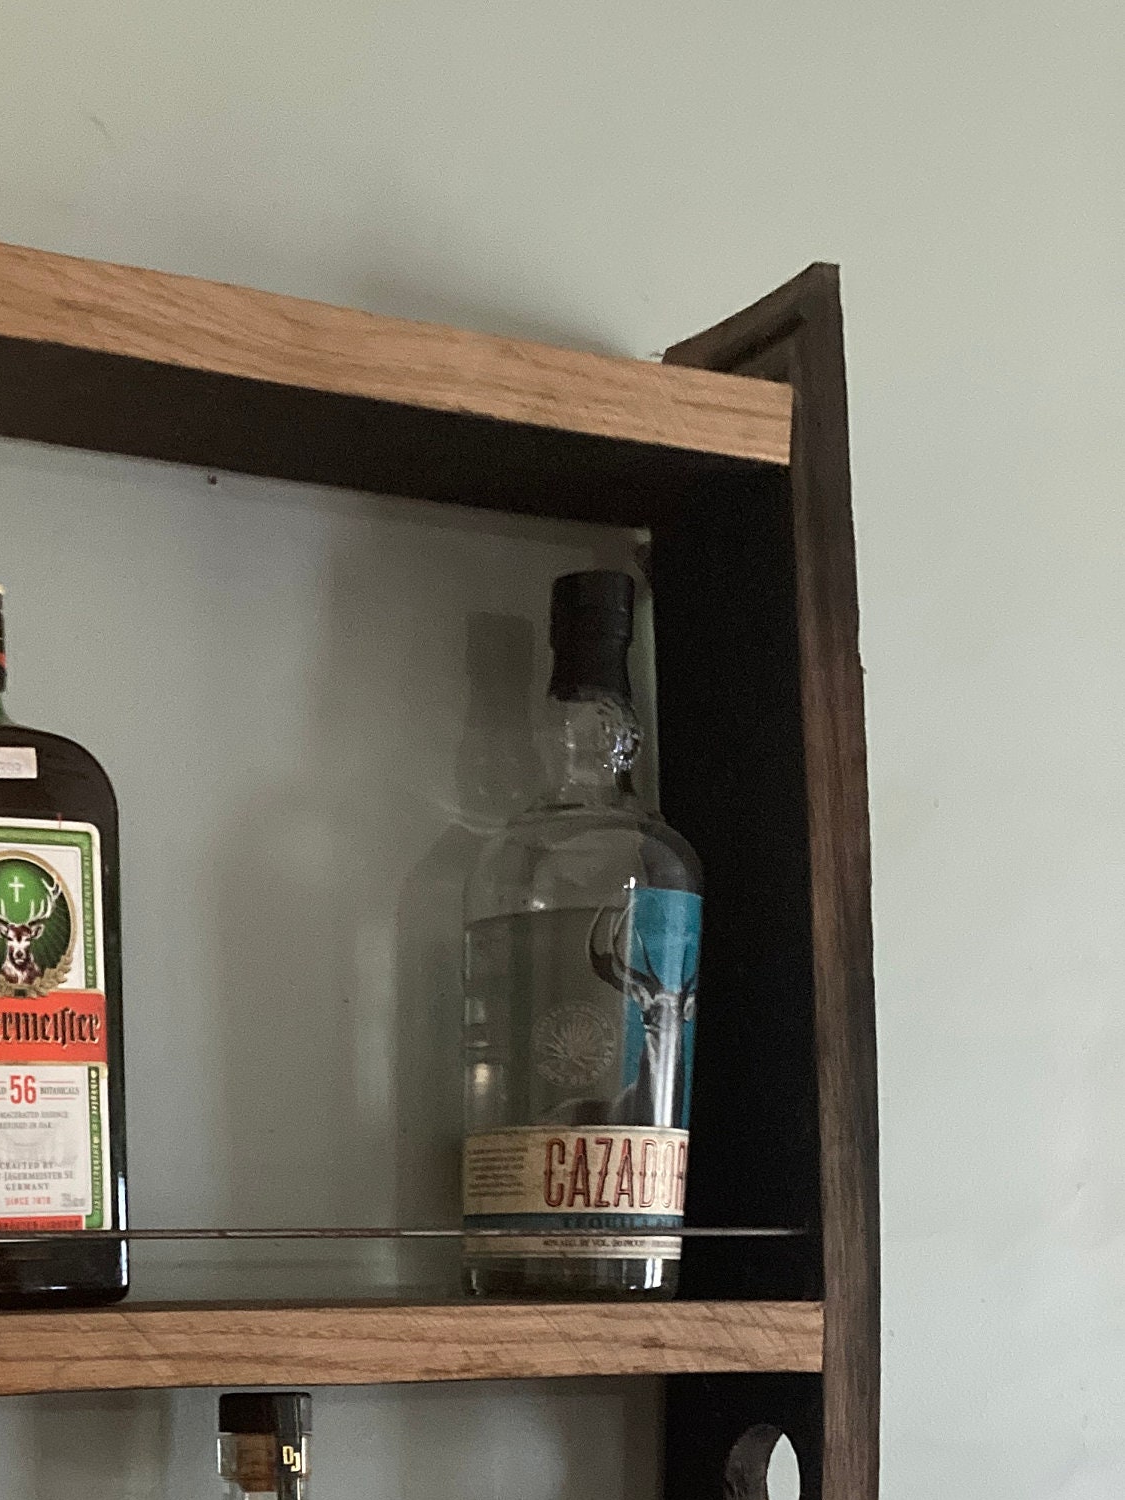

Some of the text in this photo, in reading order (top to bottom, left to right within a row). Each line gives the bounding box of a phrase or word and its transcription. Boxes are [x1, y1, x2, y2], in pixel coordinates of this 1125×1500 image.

[10, 1075, 37, 1105] 56
[0, 1161, 54, 1169] CRAFTED BY
[5, 1183, 50, 1191] GERMANY
[282, 1446, 301, 1472] DJ
